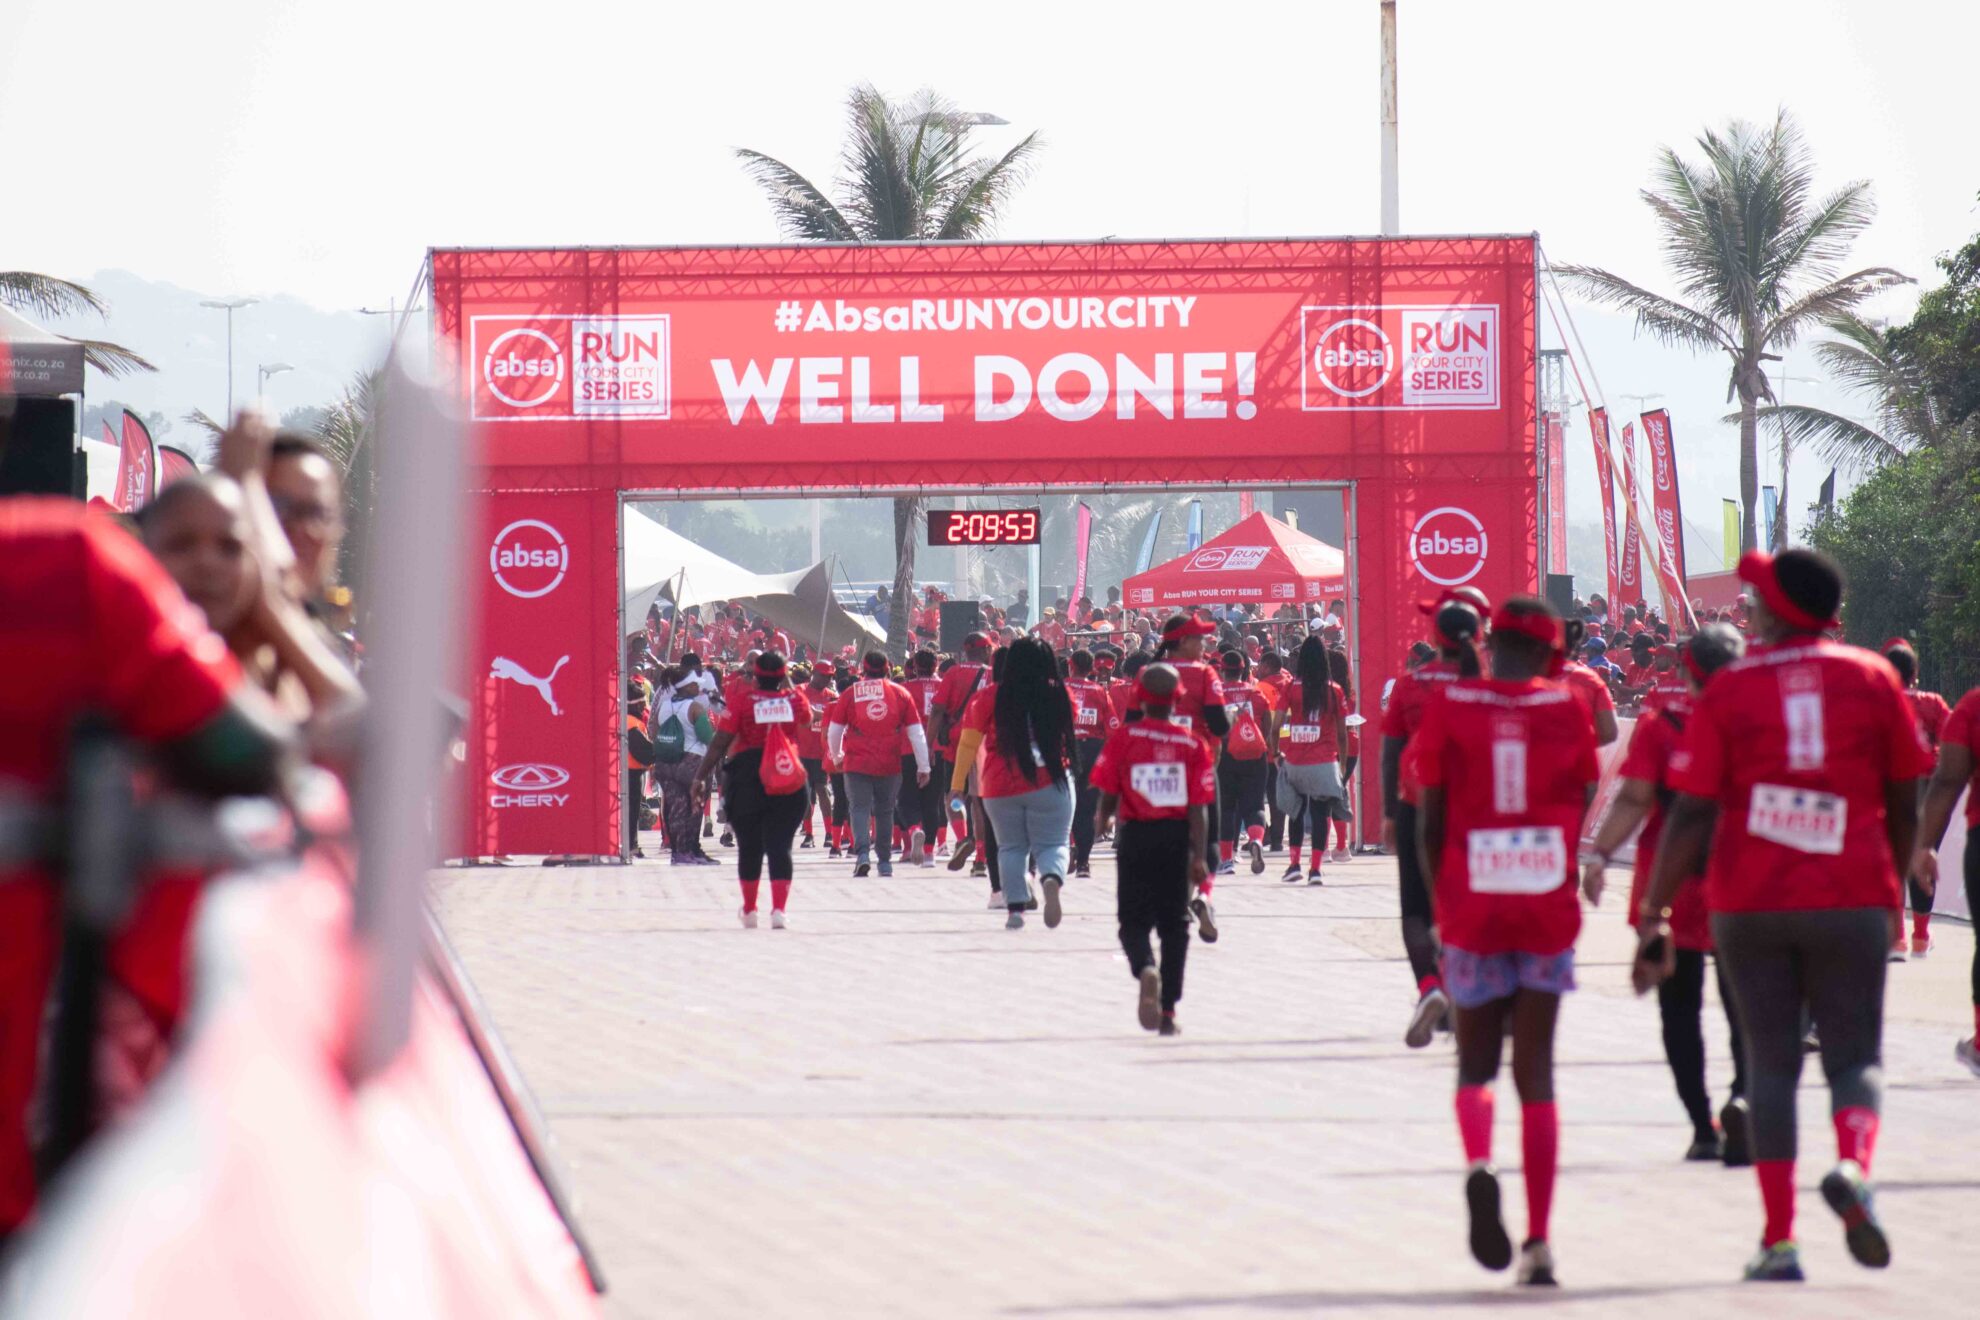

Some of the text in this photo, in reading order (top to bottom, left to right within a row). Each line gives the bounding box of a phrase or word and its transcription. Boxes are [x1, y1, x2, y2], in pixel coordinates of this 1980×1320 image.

[774, 296, 1197, 332] #AbsaRUNYOURCITY
[581, 331, 658, 363] RUN
[1411, 321, 1488, 353] RUN
[0, 356, 65, 369] anix.co.za
[493, 352, 555, 377] absa
[1323, 341, 1385, 368] absa
[1411, 356, 1484, 369] YOUR CITY
[582, 366, 654, 379] YOUR CITY
[1411, 371, 1484, 390] SERIES
[582, 381, 654, 400] SERIES
[710, 352, 1258, 426] WELL DONE!
[947, 513, 1036, 542] 2:09:53
[499, 542, 560, 568] absa
[1232, 550, 1265, 558] RUN
[1420, 530, 1479, 555] absa
[1181, 590, 1197, 598] RUN
[1198, 588, 1219, 597] YOUR
[1220, 588, 1237, 596] CITY
[1238, 588, 1263, 596] SERIES
[490, 793, 570, 808] CHERY
